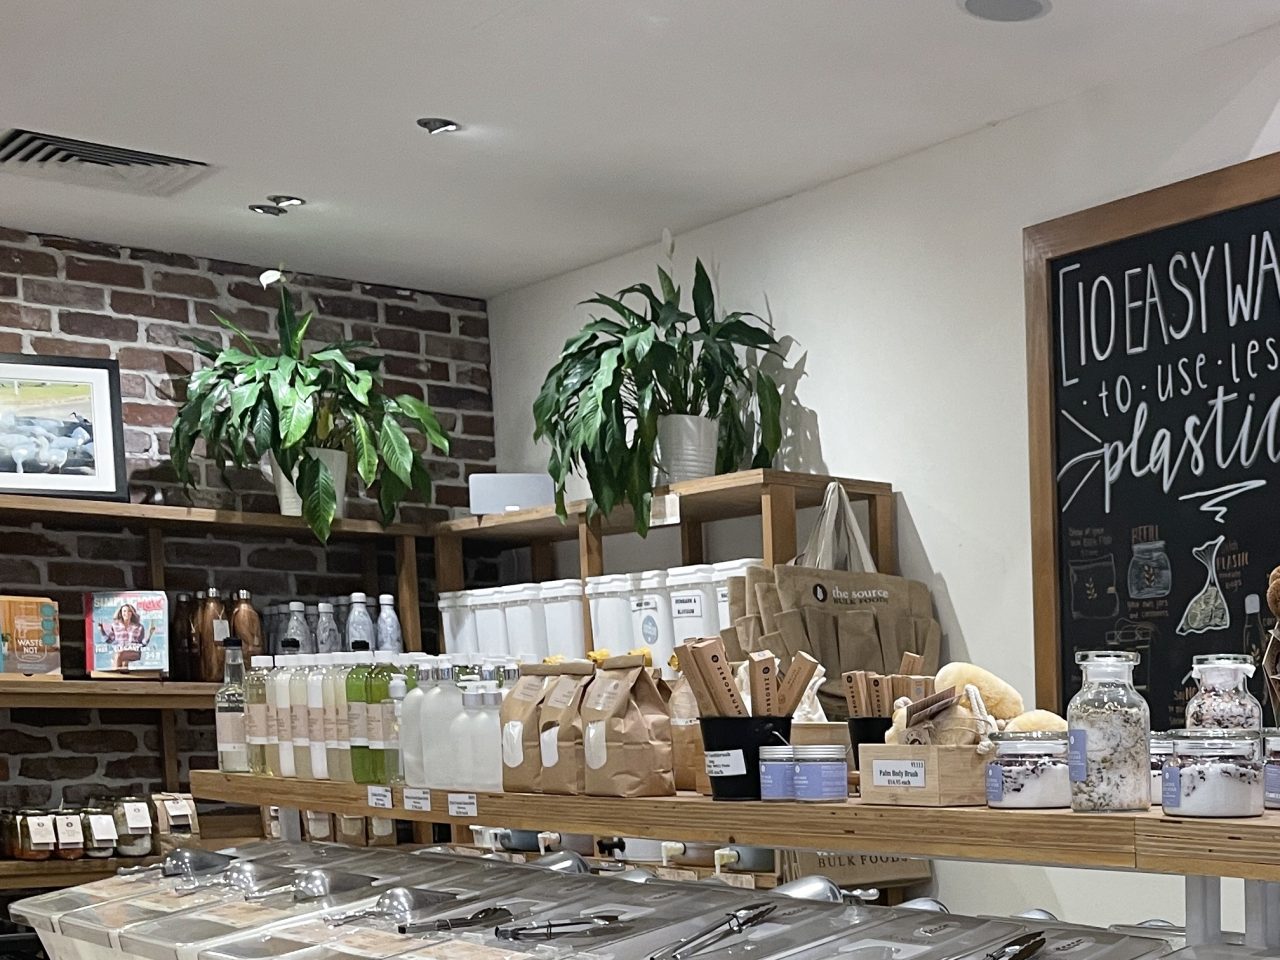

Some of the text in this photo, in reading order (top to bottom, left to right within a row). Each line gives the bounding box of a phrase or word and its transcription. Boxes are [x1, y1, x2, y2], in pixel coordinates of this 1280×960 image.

[1078, 275, 1116, 366] 10
[1124, 246, 1215, 354] EASY
[1098, 375, 1133, 417] to
[1157, 353, 1209, 402] use
[832, 585, 889, 599] the source
[17, 639, 43, 654] WASTE NOT
[817, 856, 856, 868] BULK
